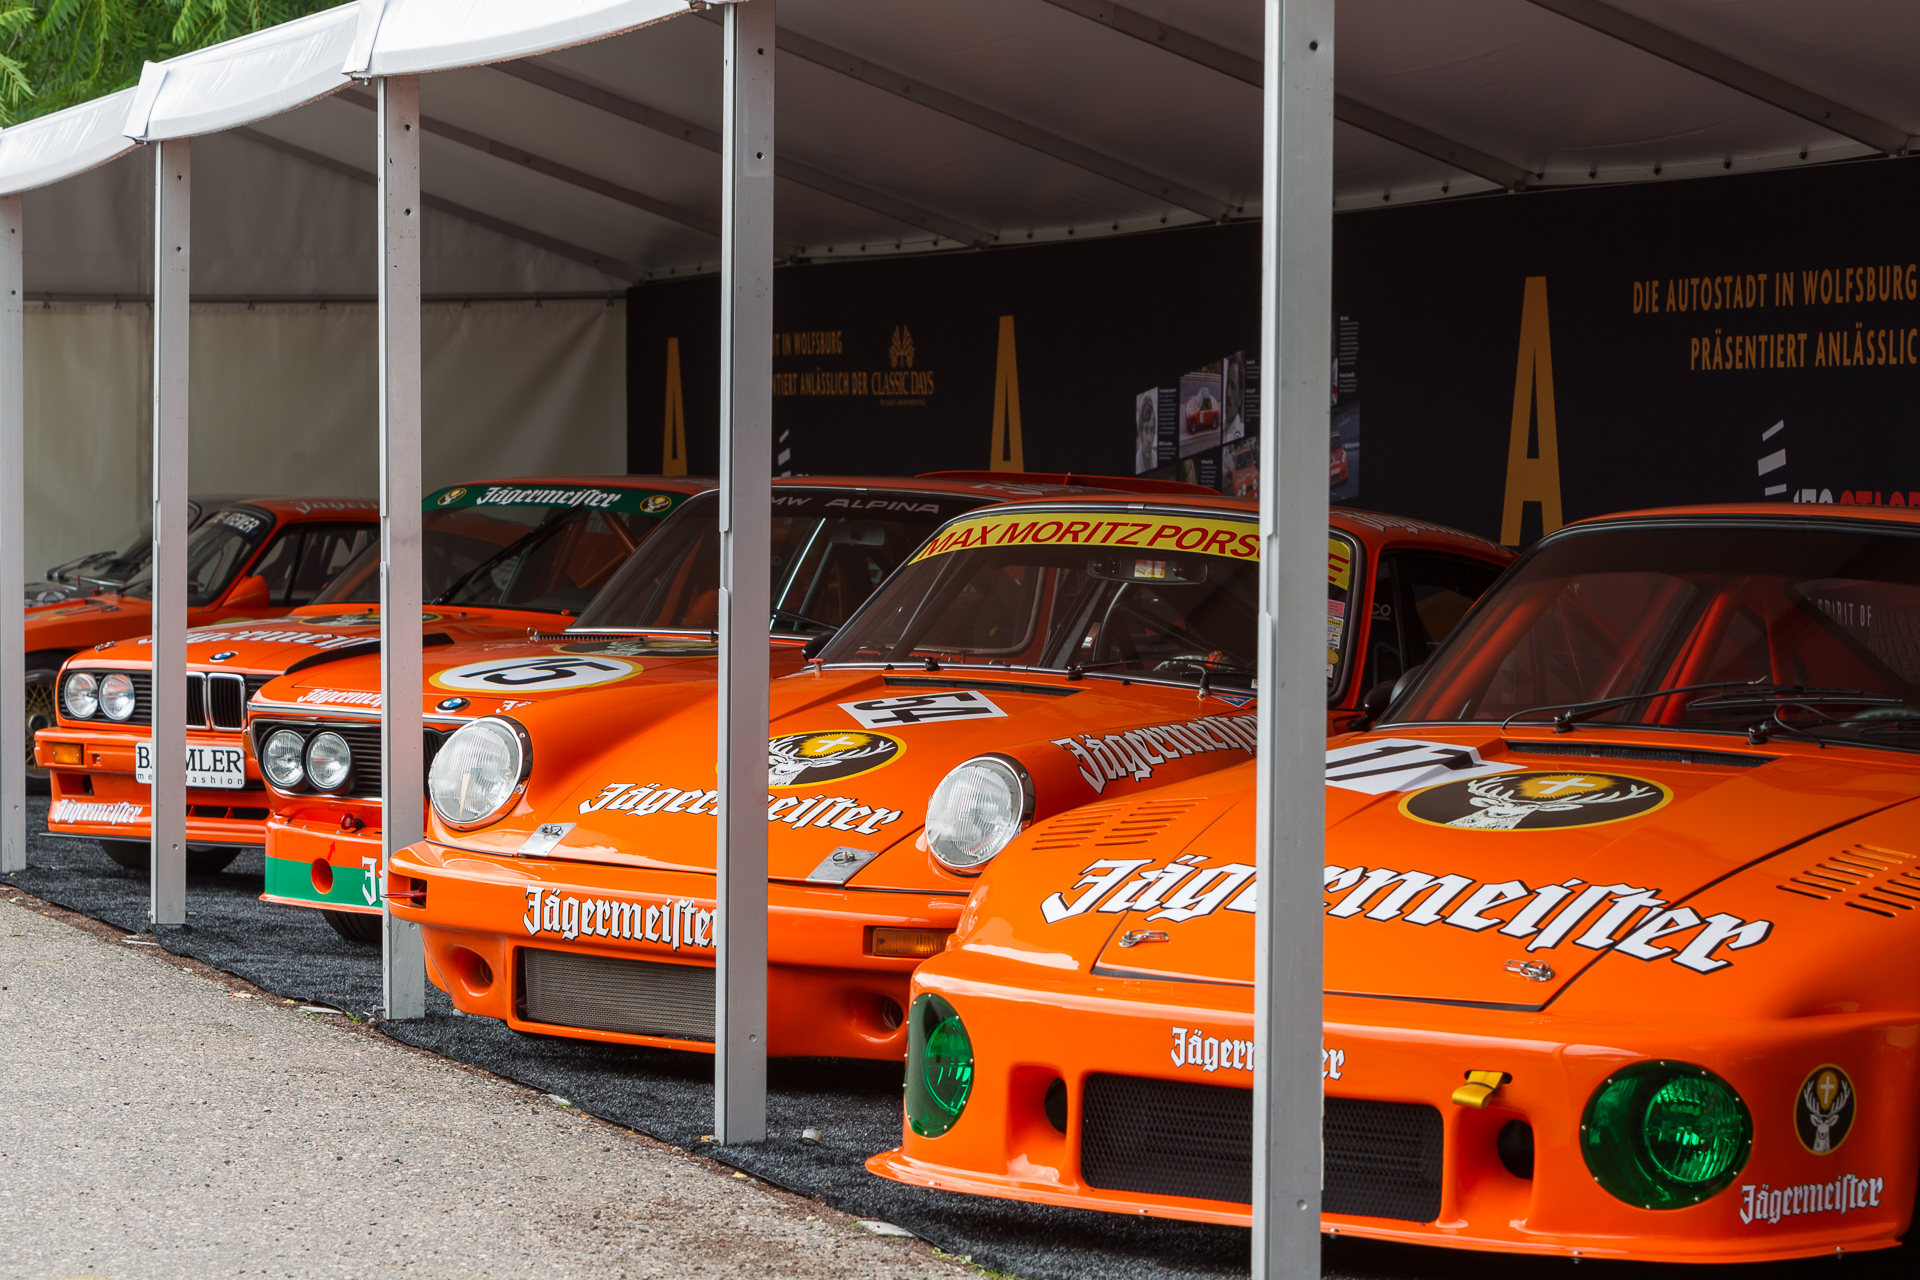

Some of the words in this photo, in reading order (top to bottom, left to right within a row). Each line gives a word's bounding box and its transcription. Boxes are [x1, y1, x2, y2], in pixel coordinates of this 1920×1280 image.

[1633, 280, 1659, 314] DIE
[1666, 273, 1768, 313] AUTOSTADT
[1775, 271, 1794, 307] IN
[1802, 263, 1918, 306] WOLFSBURG
[793, 330, 843, 356] WOLFSBURG
[1690, 328, 1808, 371] PRÄSENTIERT
[1815, 322, 1919, 368] ANLÄSSLIC
[799, 366, 850, 396] ANLÄSSLICH
[852, 370, 869, 396] DER
[871, 371, 909, 396] CLASSIC
[910, 370, 935, 396] DAYS
[476, 486, 622, 509] Jägermeister
[771, 496, 813, 507] MW
[824, 498, 940, 514] ALPINA
[918, 523, 1003, 560] MAX
[995, 520, 1153, 546] MORITZ
[1147, 523, 1350, 583] PORSE
[1859, 604, 1872, 628] OF
[458, 657, 622, 686] 15
[137, 746, 242, 774] BMLER
[54, 798, 144, 826] Jägermeister
[577, 782, 903, 836] Jägereister
[1739, 1172, 1885, 1225] Jägermeister
